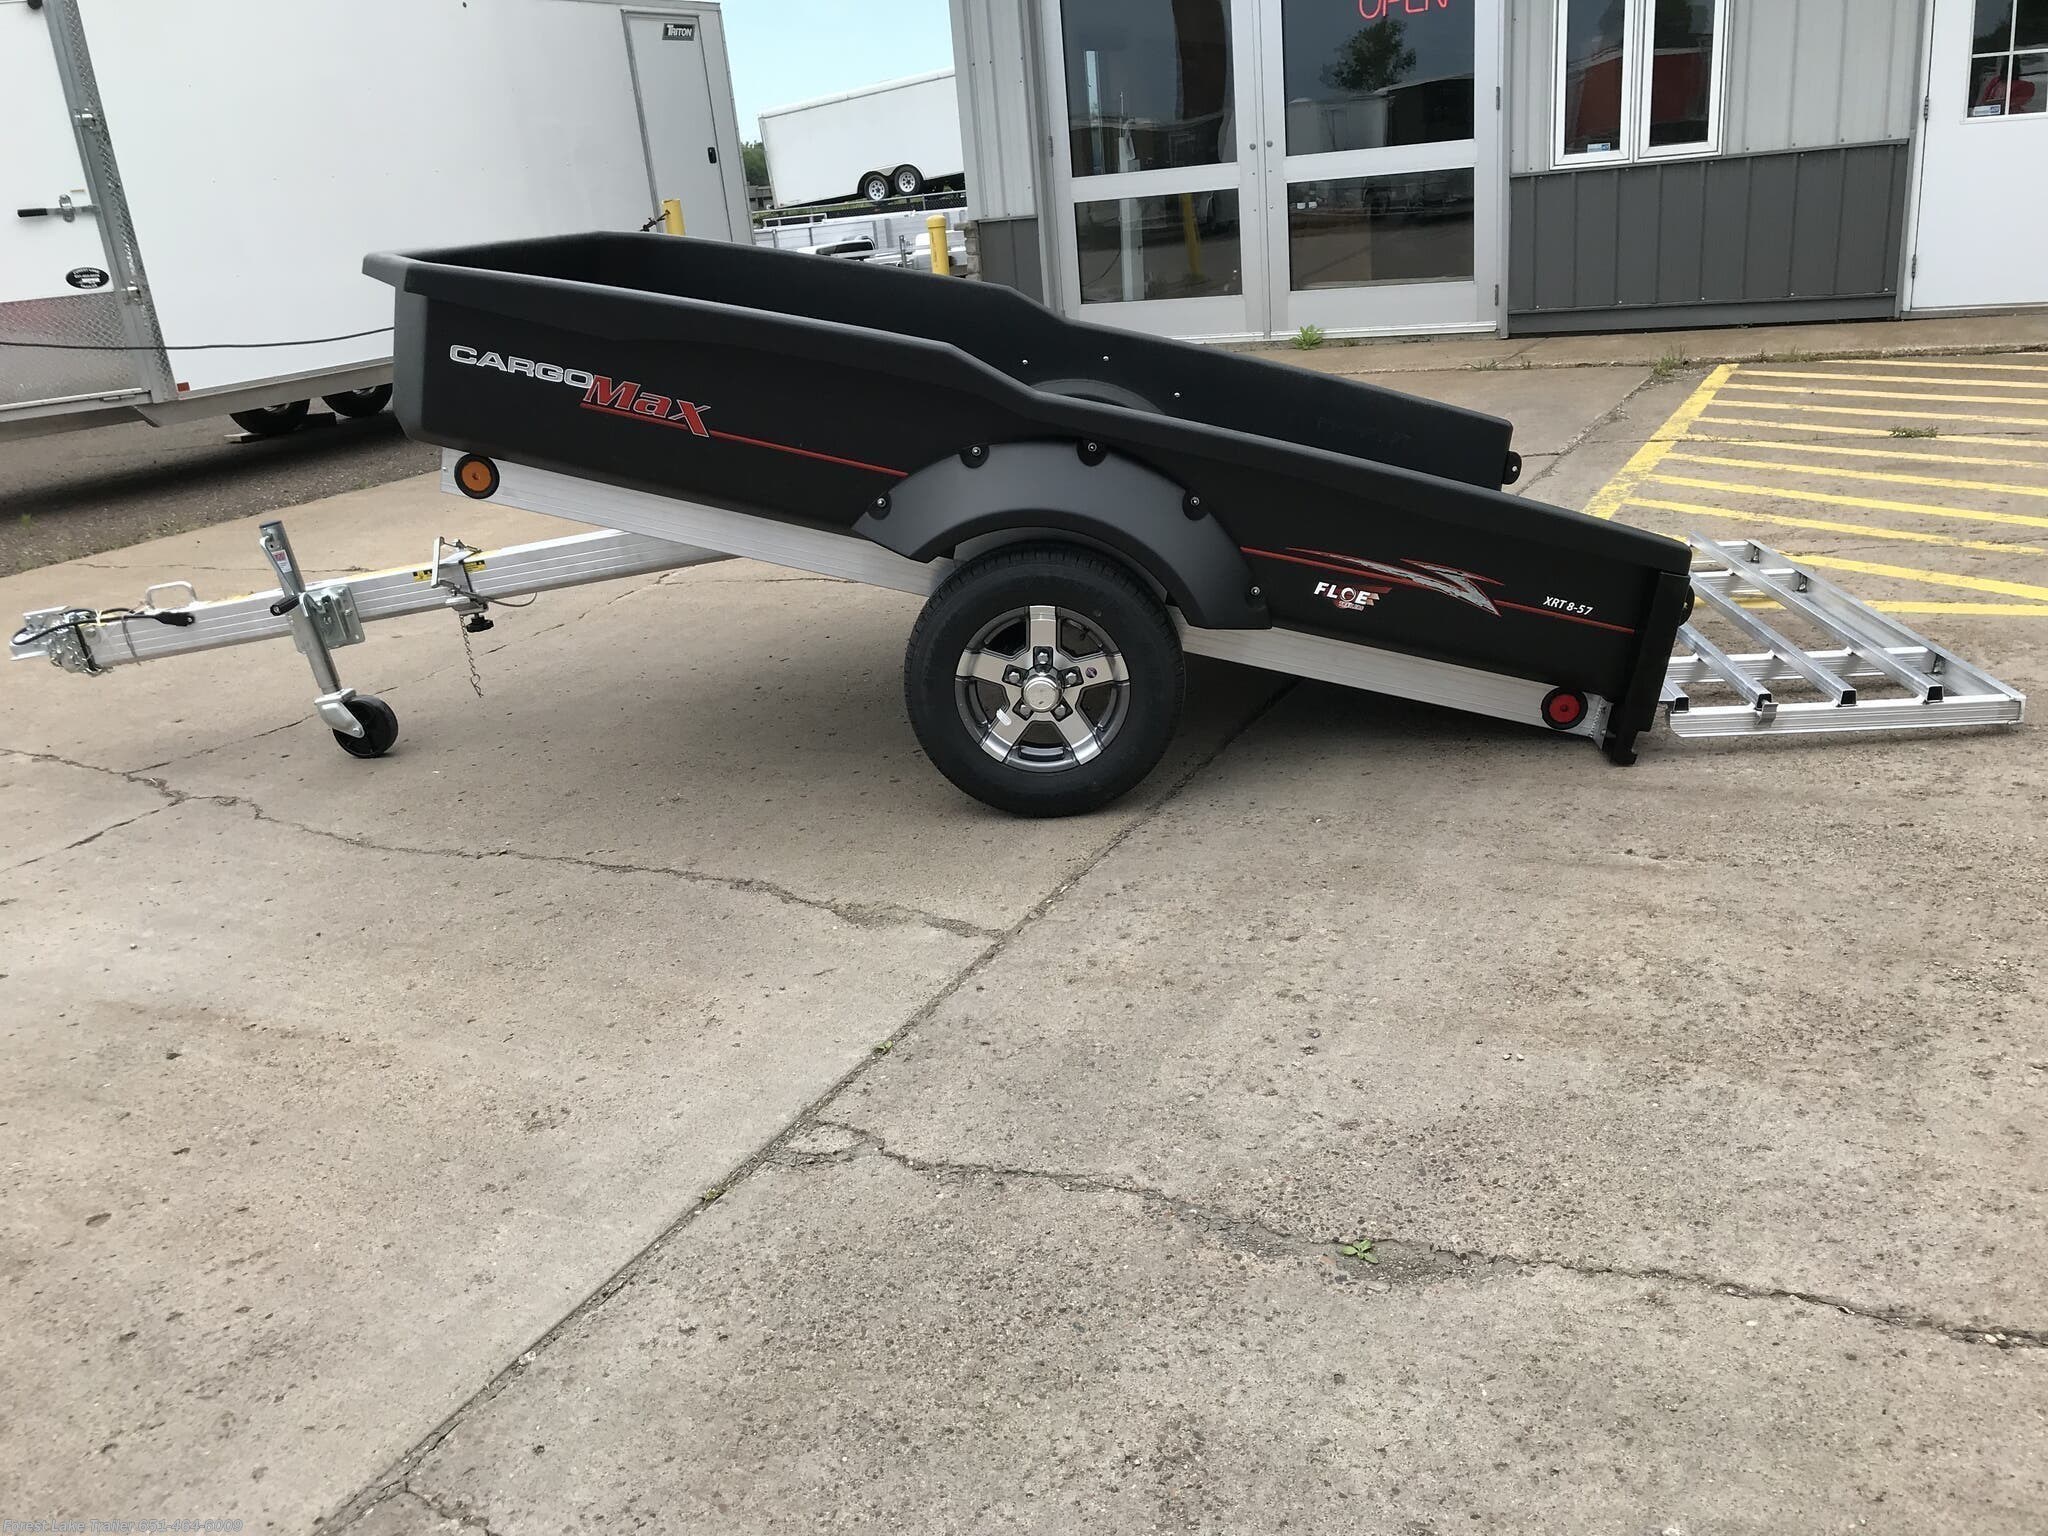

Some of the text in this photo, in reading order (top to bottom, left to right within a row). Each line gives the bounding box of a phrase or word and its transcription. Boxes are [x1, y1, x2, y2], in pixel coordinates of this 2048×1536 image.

[667, 24, 692, 36] TRITON
[1313, 581, 1372, 606] FLOE
[1543, 596, 1594, 615] XRT 8-57
